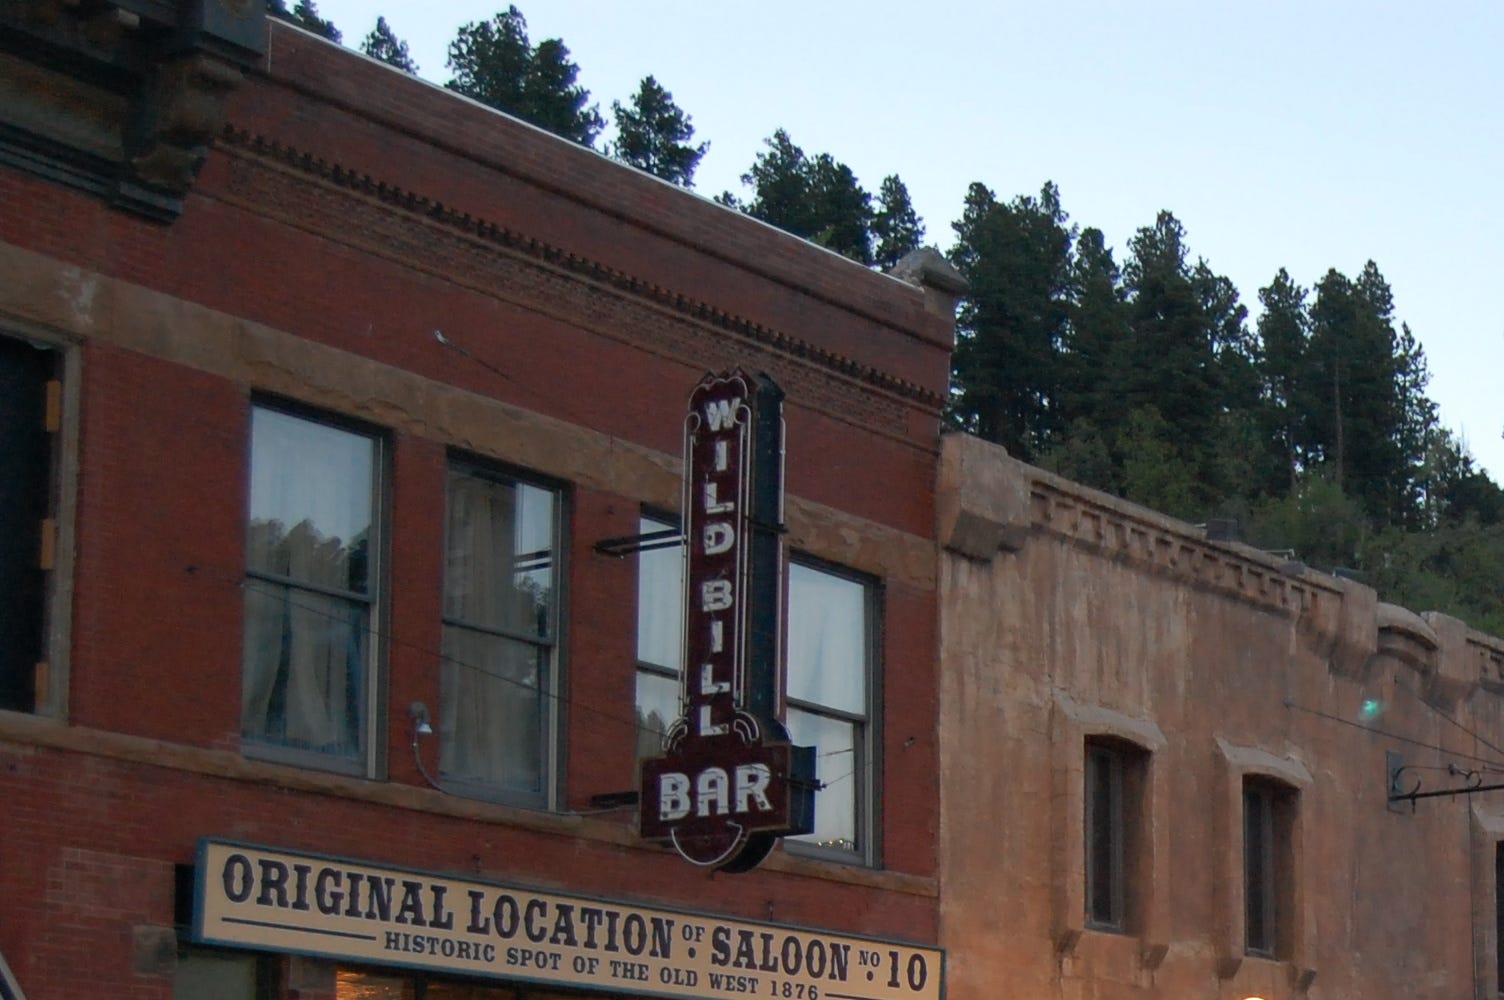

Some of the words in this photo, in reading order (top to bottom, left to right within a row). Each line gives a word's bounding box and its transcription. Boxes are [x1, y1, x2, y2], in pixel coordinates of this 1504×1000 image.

[702, 398, 739, 555] WILD
[698, 579, 735, 737] BILL
[659, 762, 773, 821] BAR
[221, 853, 454, 929] ORIGINAL
[466, 886, 675, 960] LOCATION
[710, 926, 850, 983] SALOON
[886, 949, 928, 992] 10
[383, 930, 497, 964] HISTORIC
[505, 945, 562, 972] SPOT
[572, 954, 600, 975] OF
[609, 959, 651, 983] THE
[659, 964, 699, 989] OLD
[708, 971, 760, 996] WEST
